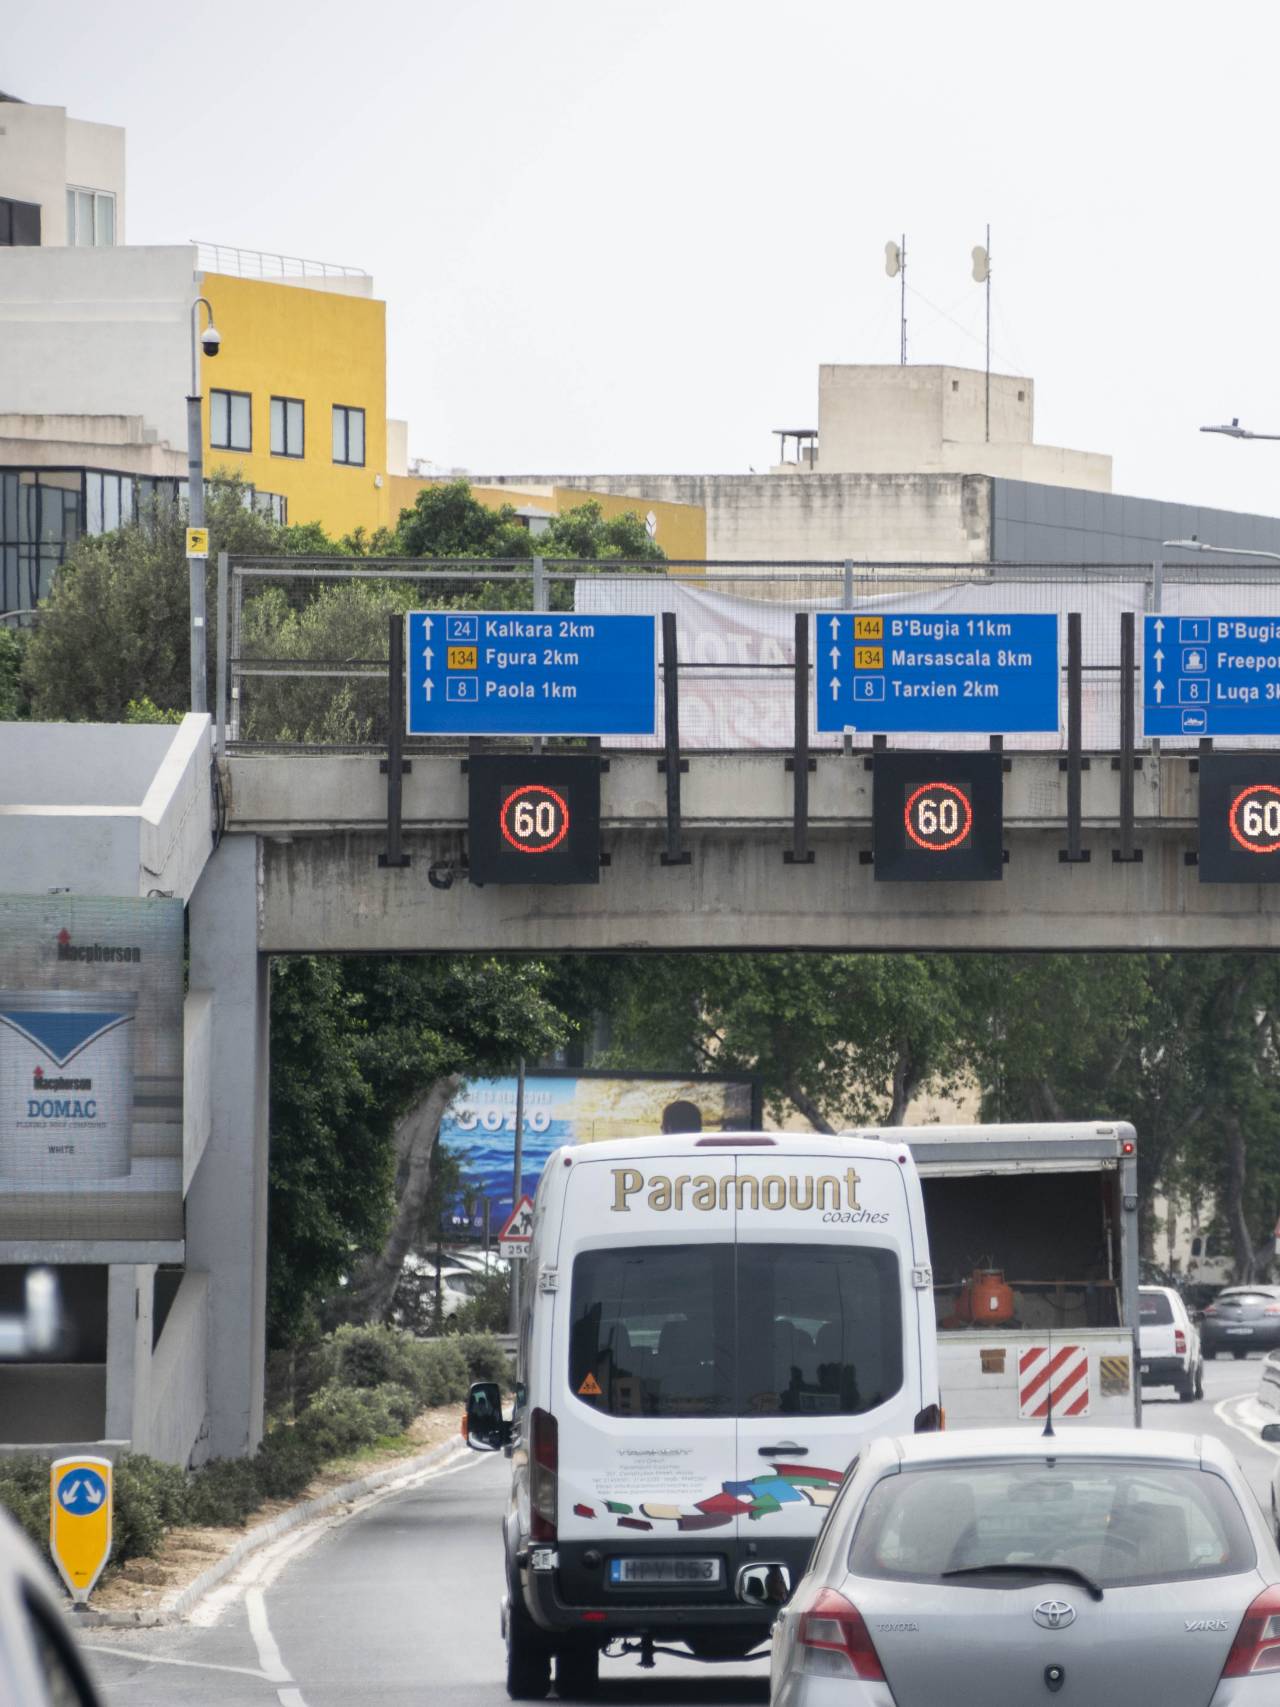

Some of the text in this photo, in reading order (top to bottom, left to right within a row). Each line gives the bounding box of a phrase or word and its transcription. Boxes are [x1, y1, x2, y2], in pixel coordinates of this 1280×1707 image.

[453, 620, 595, 638] 24 Kalkara 2km
[856, 620, 1012, 640] 144 B'Bugia 11km
[1191, 623, 1199, 638] 1
[450, 648, 579, 668] 134 Fgura 2km
[857, 649, 1032, 666] 134 Marsascala 8km
[457, 681, 577, 698] 8 Paola 1km
[864, 680, 999, 697] 8 Tarxien 2km
[1190, 683, 1199, 699] 8
[1216, 682, 1259, 703] Luqa
[515, 801, 555, 837] 60
[919, 799, 958, 834] 60
[58, 943, 141, 963] Macpherson
[34, 1075, 92, 1092] Macpherson
[27, 1099, 97, 1119] DOMAC
[48, 1145, 75, 1154] WHITE
[610, 1167, 861, 1211] Paramount
[822, 1209, 890, 1224] coaches
